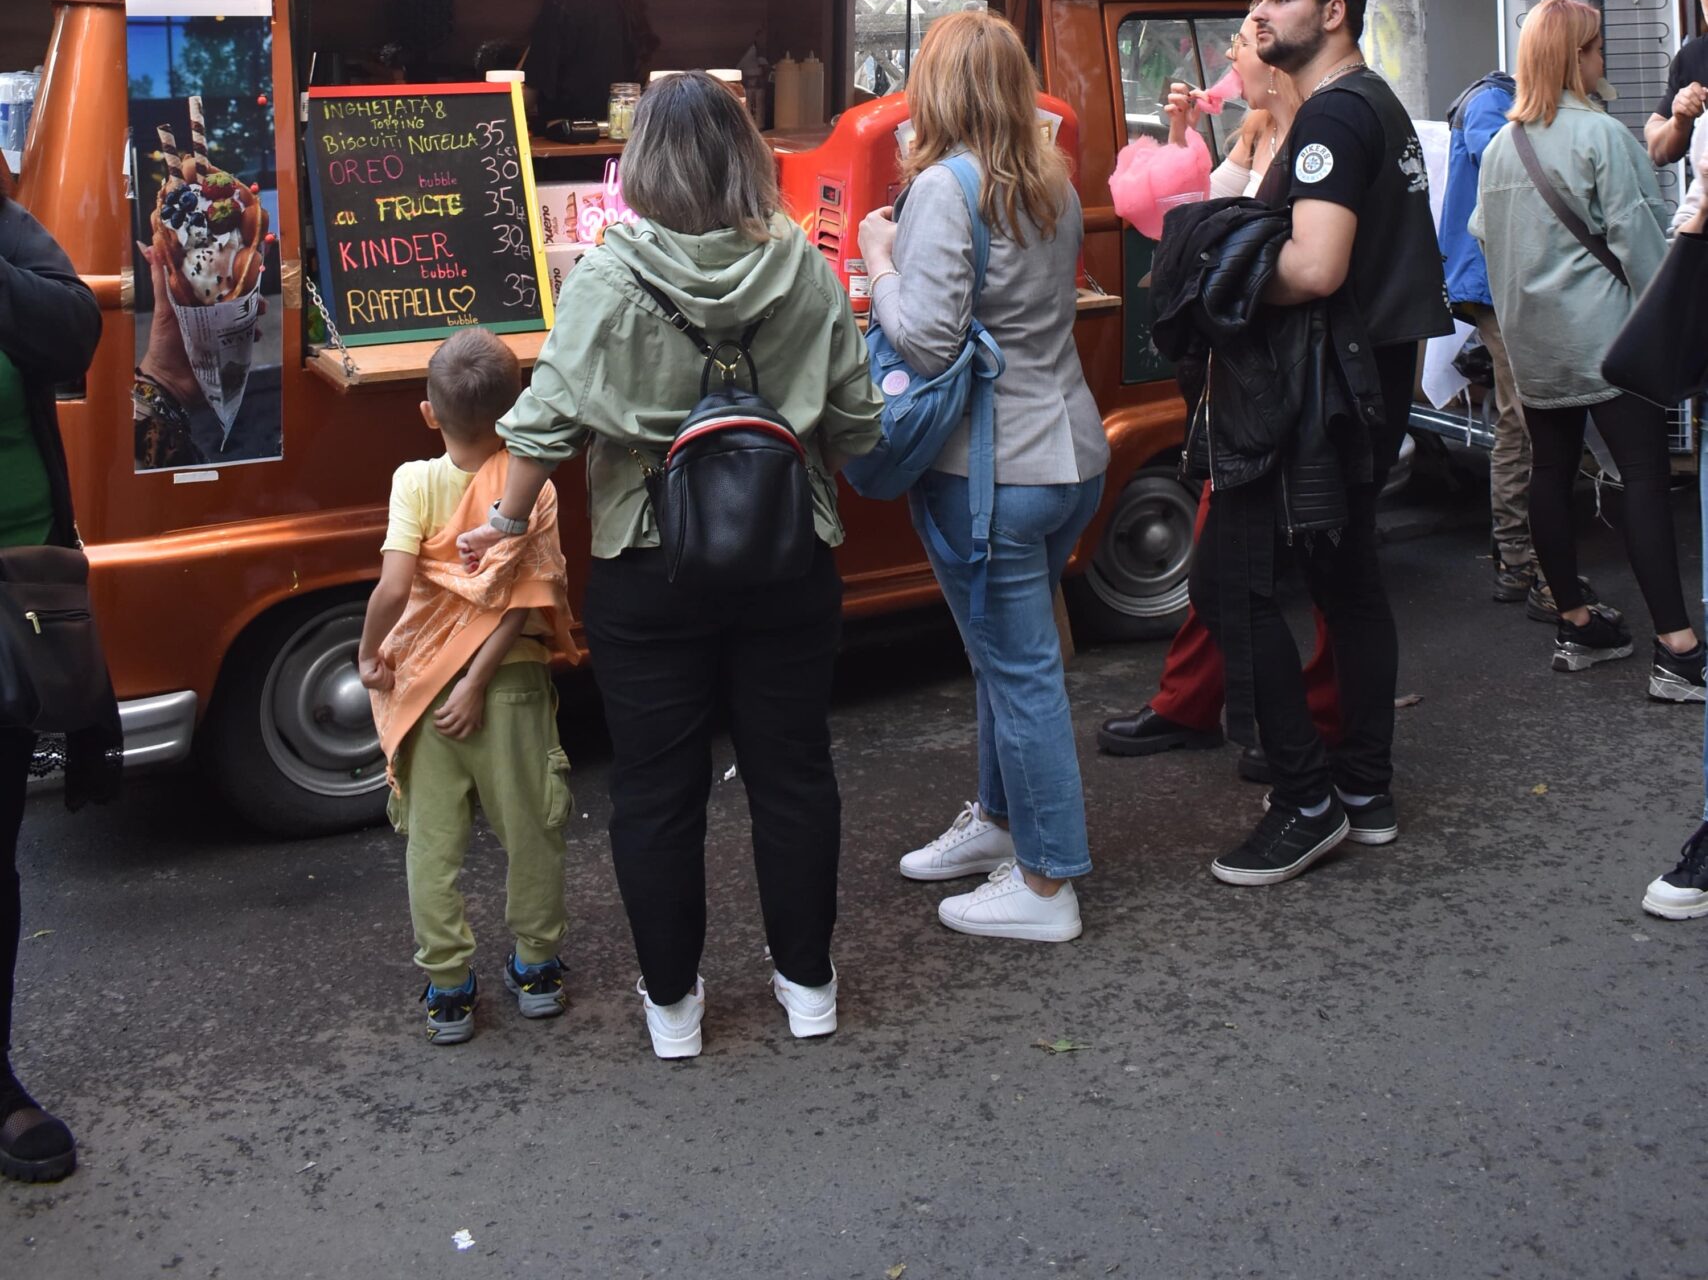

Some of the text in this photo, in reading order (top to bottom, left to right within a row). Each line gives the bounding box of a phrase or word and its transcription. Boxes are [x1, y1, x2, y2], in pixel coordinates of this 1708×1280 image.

[407, 132, 478, 155] NUTELLA
[476, 119, 507, 150] 35
[1300, 144, 1331, 160] BIKERS
[329, 154, 519, 185] OREO 30
[418, 170, 459, 189] bubble
[374, 193, 465, 222] FRUCTE
[484, 186, 515, 216] 35
[339, 232, 454, 272] KINDER
[492, 224, 524, 254] 30
[421, 262, 468, 280] bubble
[503, 273, 537, 308] 35
[447, 313, 480, 326] bubble
